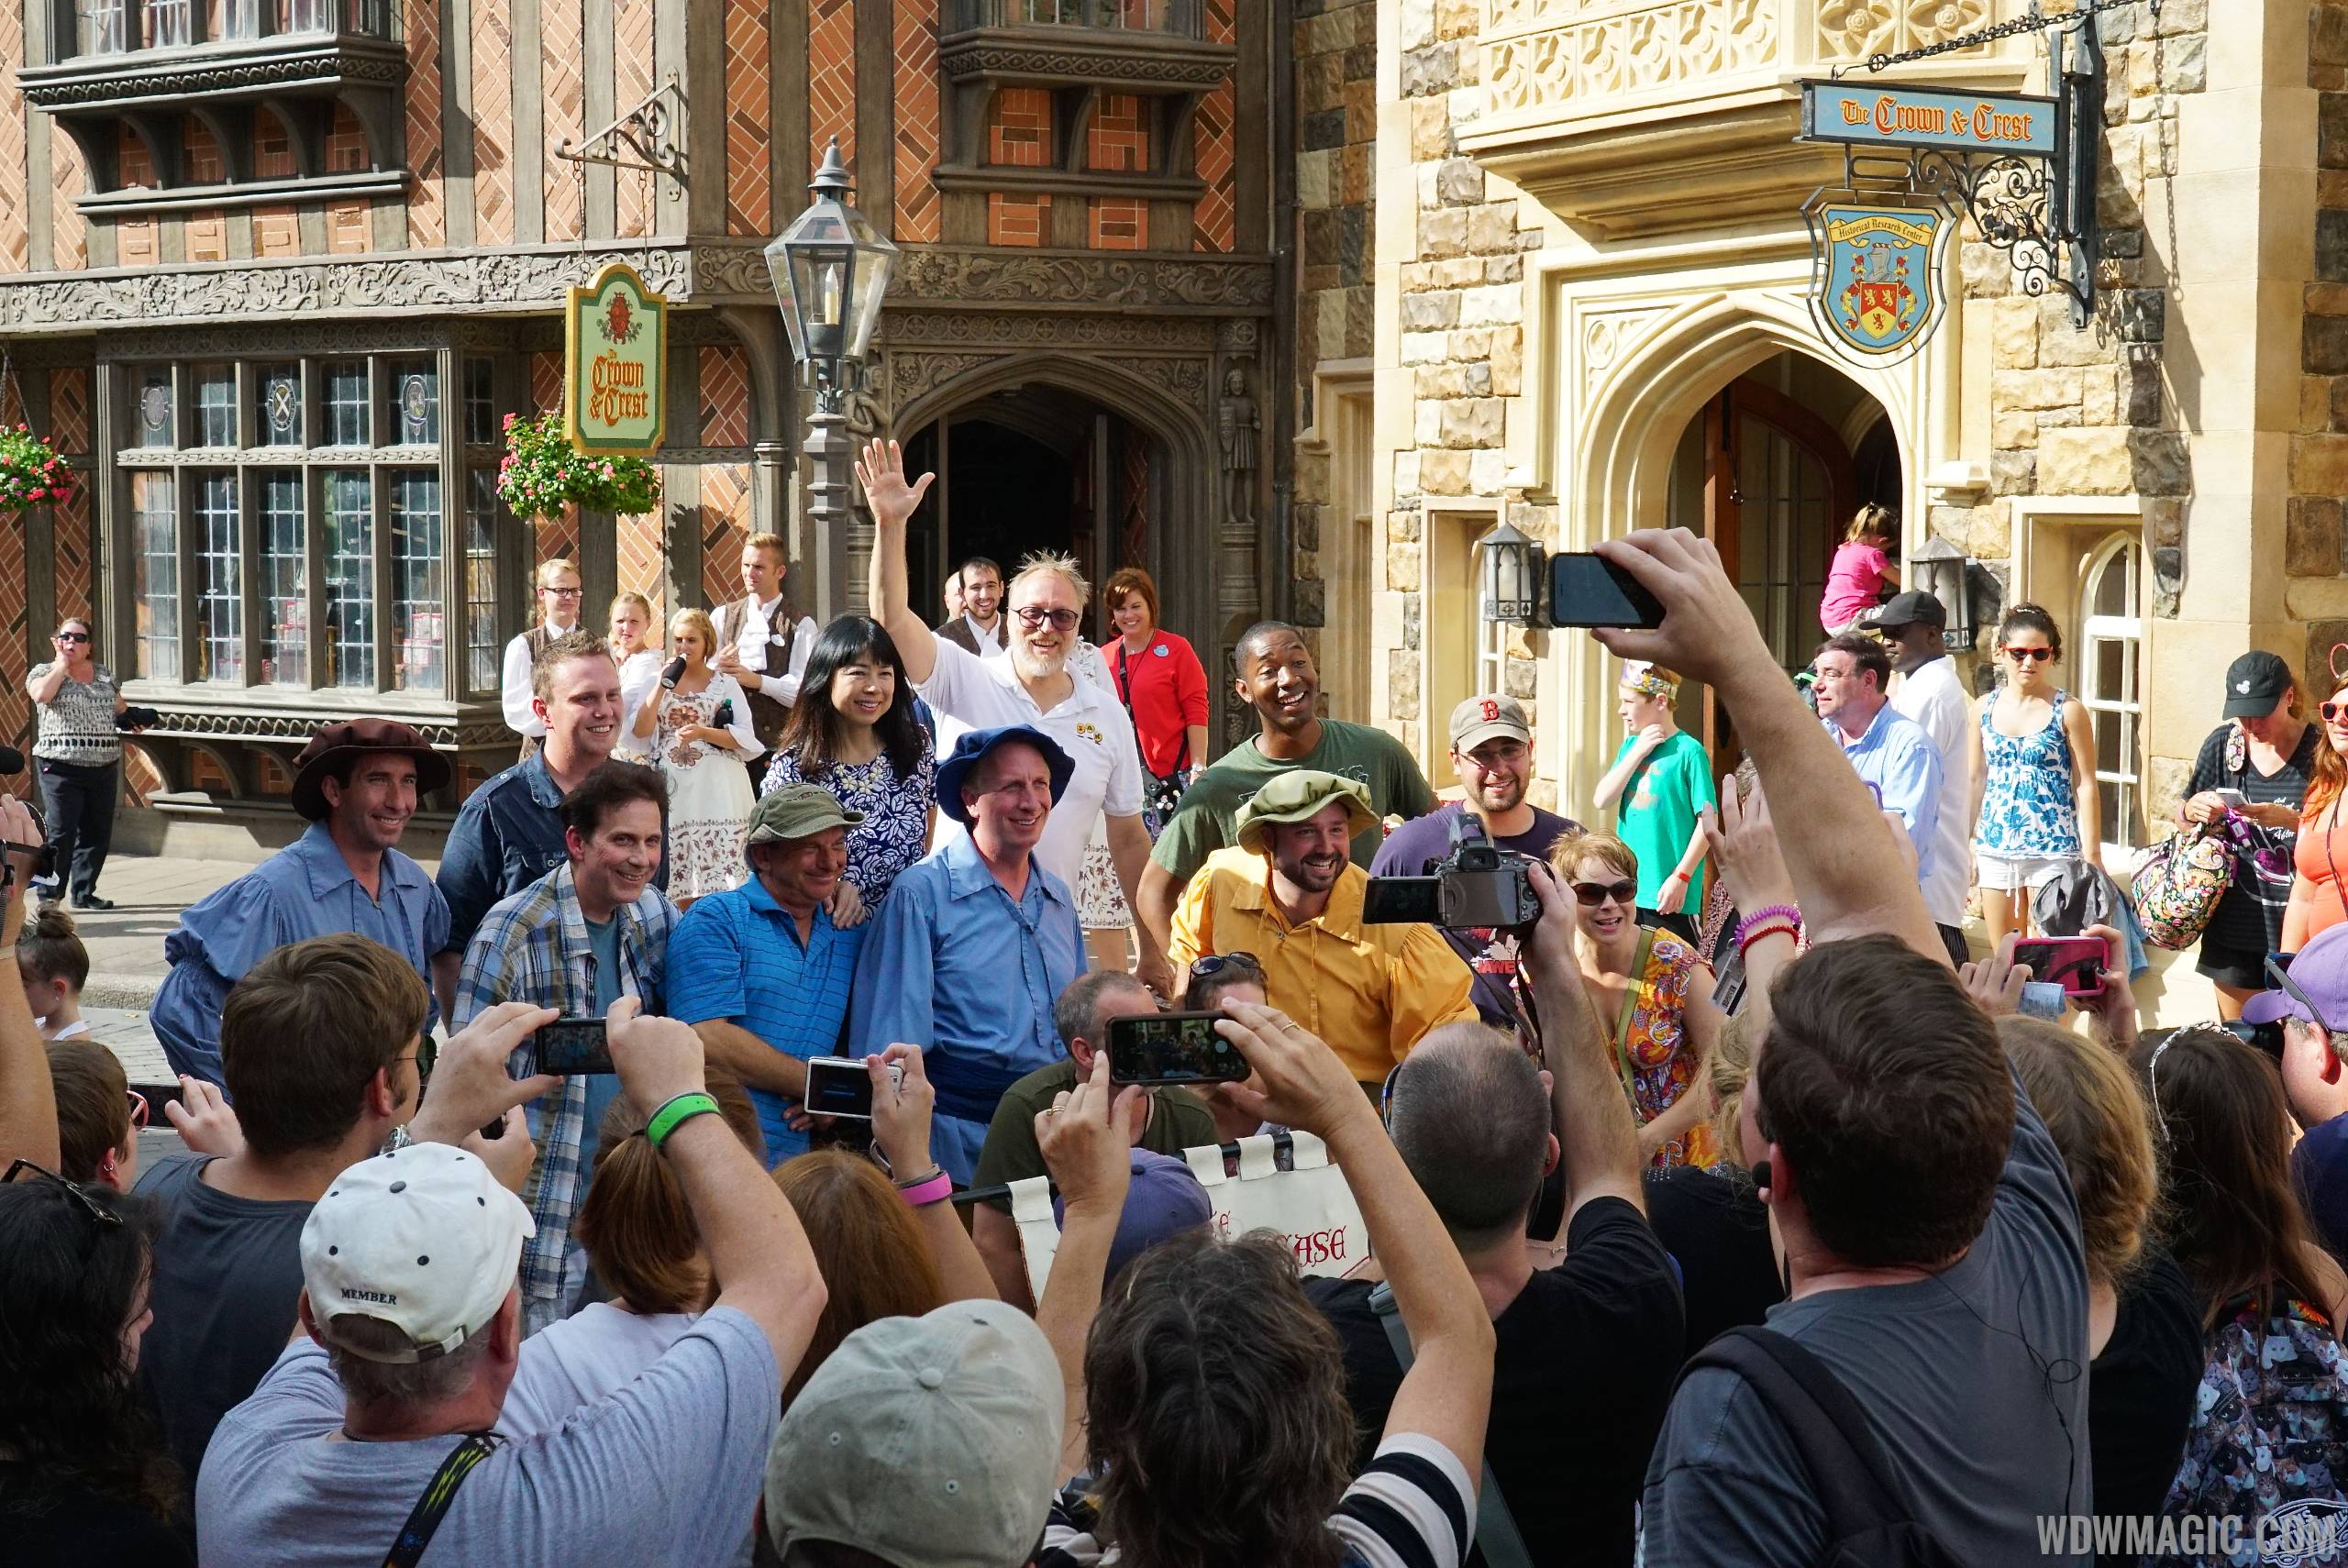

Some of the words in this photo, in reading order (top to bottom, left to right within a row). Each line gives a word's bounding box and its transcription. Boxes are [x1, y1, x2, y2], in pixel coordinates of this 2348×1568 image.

[1840, 99, 1870, 125] The
[1874, 94, 1947, 135] Crown
[1950, 108, 1970, 136] &
[1972, 102, 2032, 142] Crest
[1838, 221, 1870, 238] Historical
[1871, 218, 1901, 235] Research
[1902, 226, 1923, 241] Center
[590, 353, 645, 396] Crown
[588, 393, 603, 420] &
[603, 386, 648, 425] Crest
[1479, 699, 1500, 722] B
[340, 1287, 397, 1305] MEMBER
